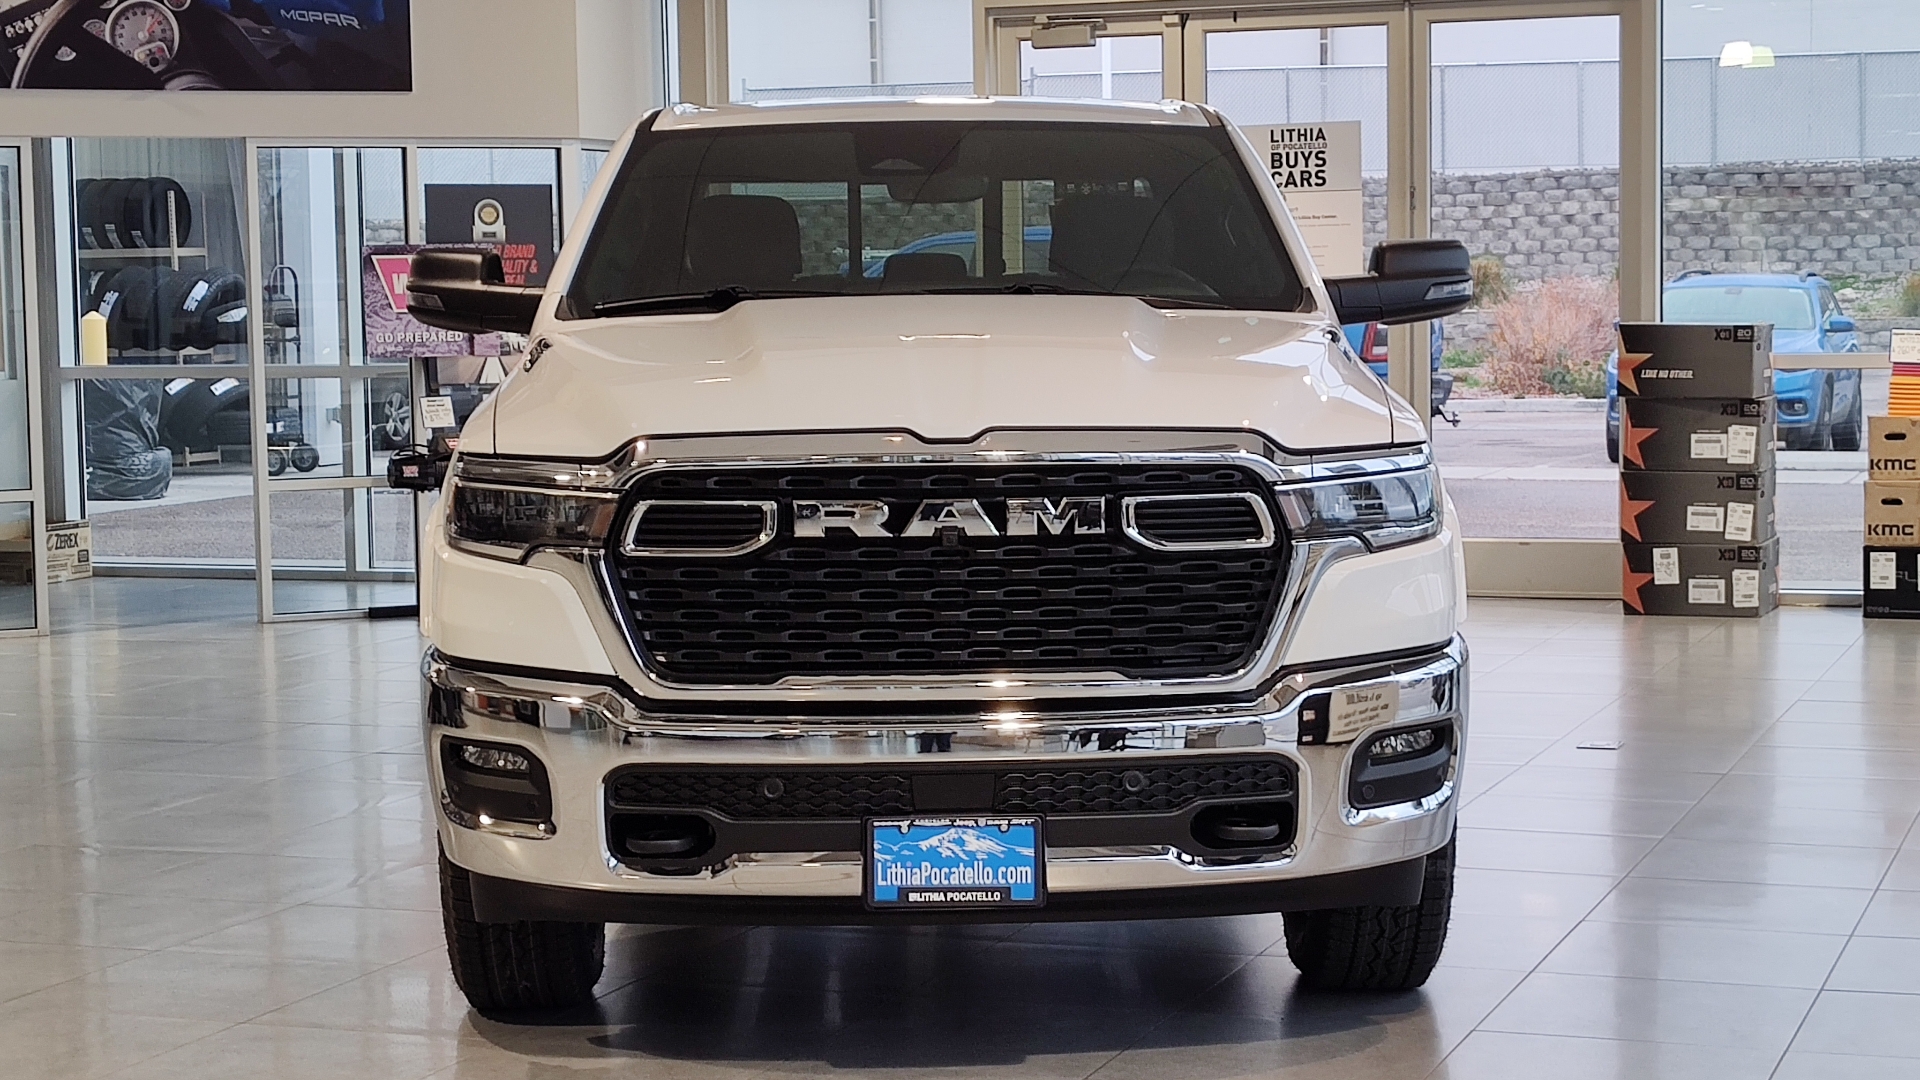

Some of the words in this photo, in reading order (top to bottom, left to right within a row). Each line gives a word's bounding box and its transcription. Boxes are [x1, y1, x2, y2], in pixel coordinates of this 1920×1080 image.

[280, 9, 361, 29] MOPAR
[1270, 127, 1327, 143] LITHIA
[1282, 142, 1328, 150] POCATELLO
[1270, 150, 1327, 169] BUYS
[1271, 170, 1327, 188] CARS
[503, 244, 536, 258] BRAND
[502, 259, 529, 274] ALITY
[376, 333, 394, 343] GO
[397, 332, 464, 343] PREPARED
[792, 497, 1105, 537] RAM
[54, 532, 79, 550] ZEREX
[877, 861, 1032, 886] LithiaPocatello.com
[917, 892, 946, 902] LITHIA
[946, 892, 1001, 902] POCATELLO
